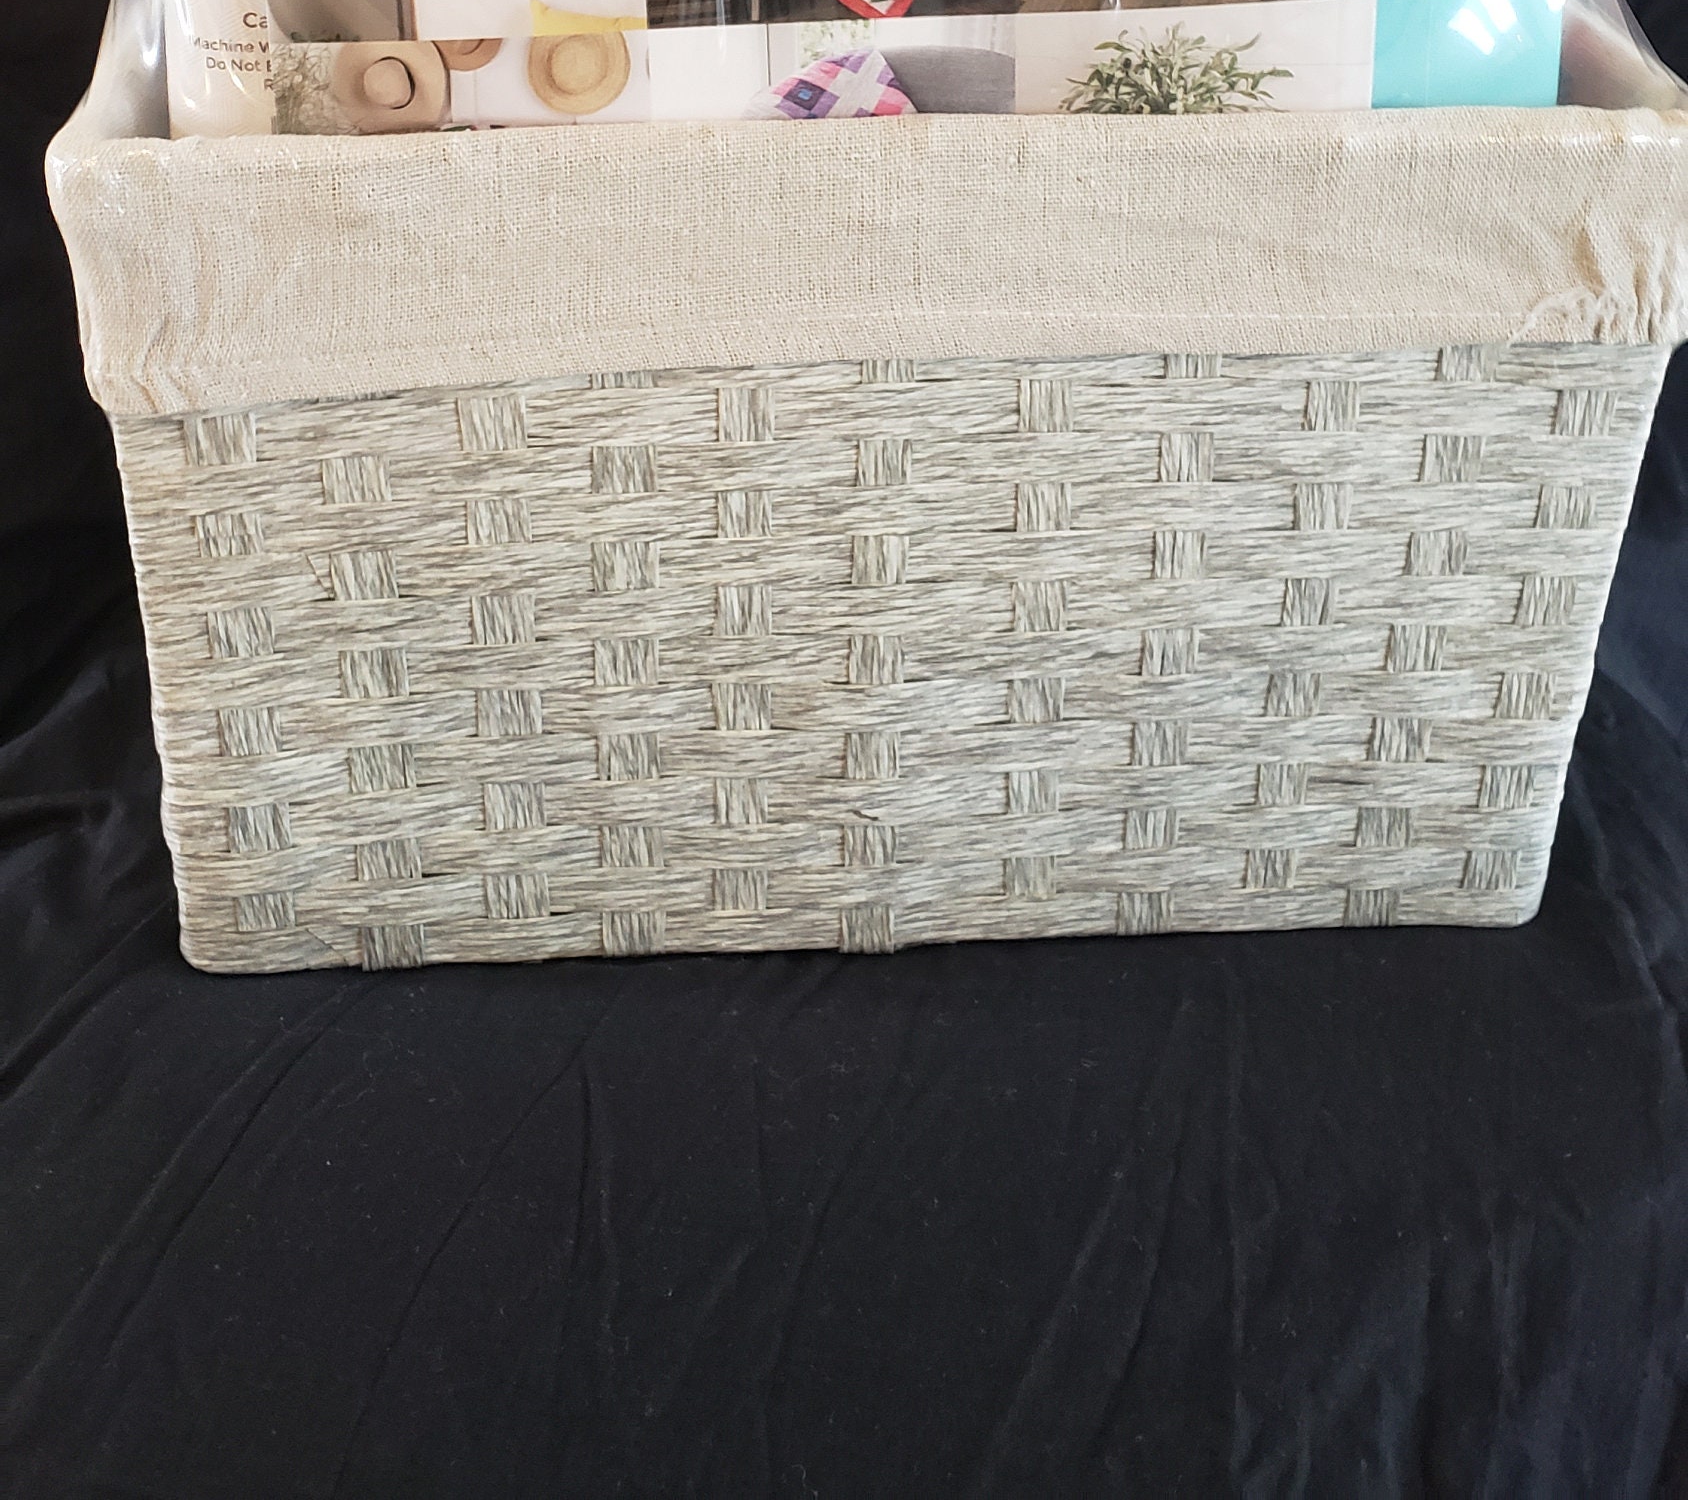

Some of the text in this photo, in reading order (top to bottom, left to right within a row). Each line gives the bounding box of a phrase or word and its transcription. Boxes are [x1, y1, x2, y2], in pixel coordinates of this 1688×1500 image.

[242, 12, 268, 29] Ca
[189, 37, 255, 53] Machine
[206, 56, 226, 70] Do
[231, 59, 262, 72] Not
